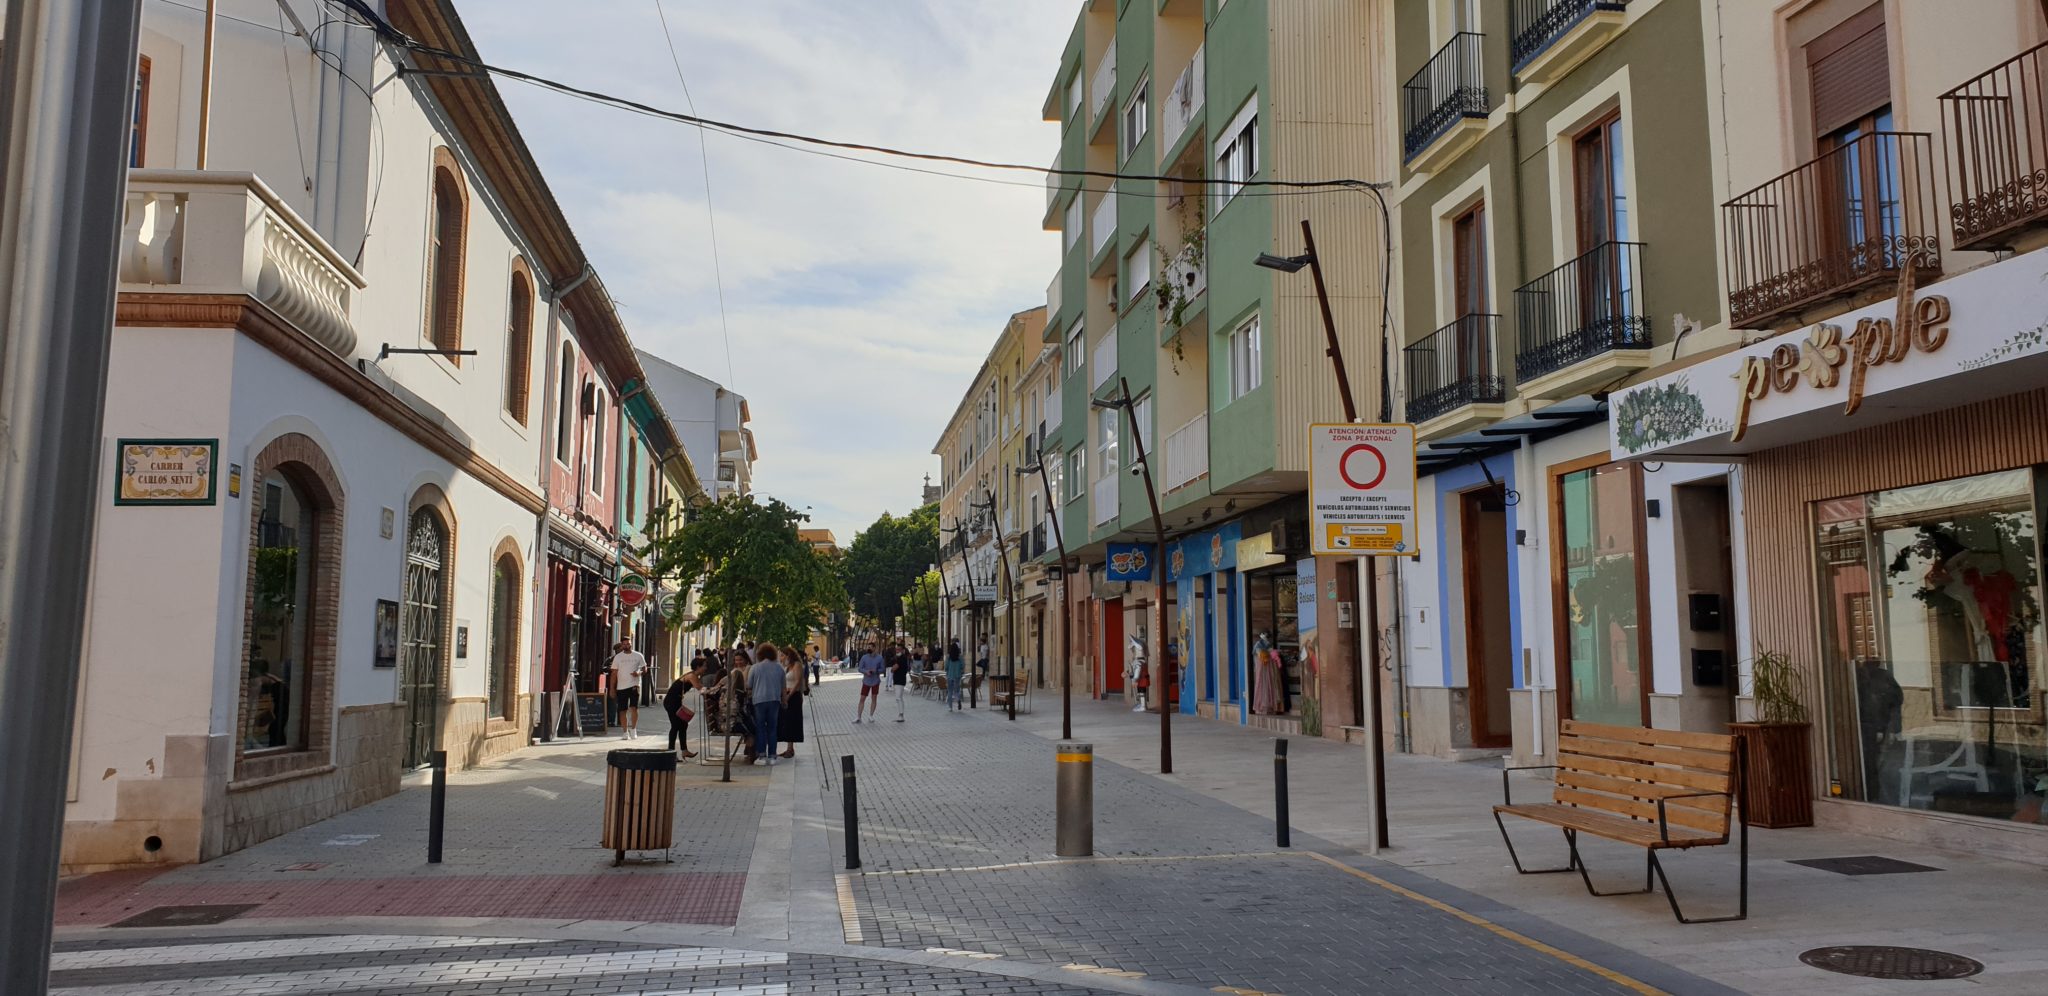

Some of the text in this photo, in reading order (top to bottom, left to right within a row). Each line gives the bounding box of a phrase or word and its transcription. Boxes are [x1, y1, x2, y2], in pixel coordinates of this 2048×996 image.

[1367, 427, 1397, 435] ATENCIÓ
[150, 462, 183, 470] CARRER
[138, 473, 193, 485] CARLOS SENTÍ
[1298, 573, 1316, 588] Zapatos
[1299, 592, 1316, 604] Bolsos
